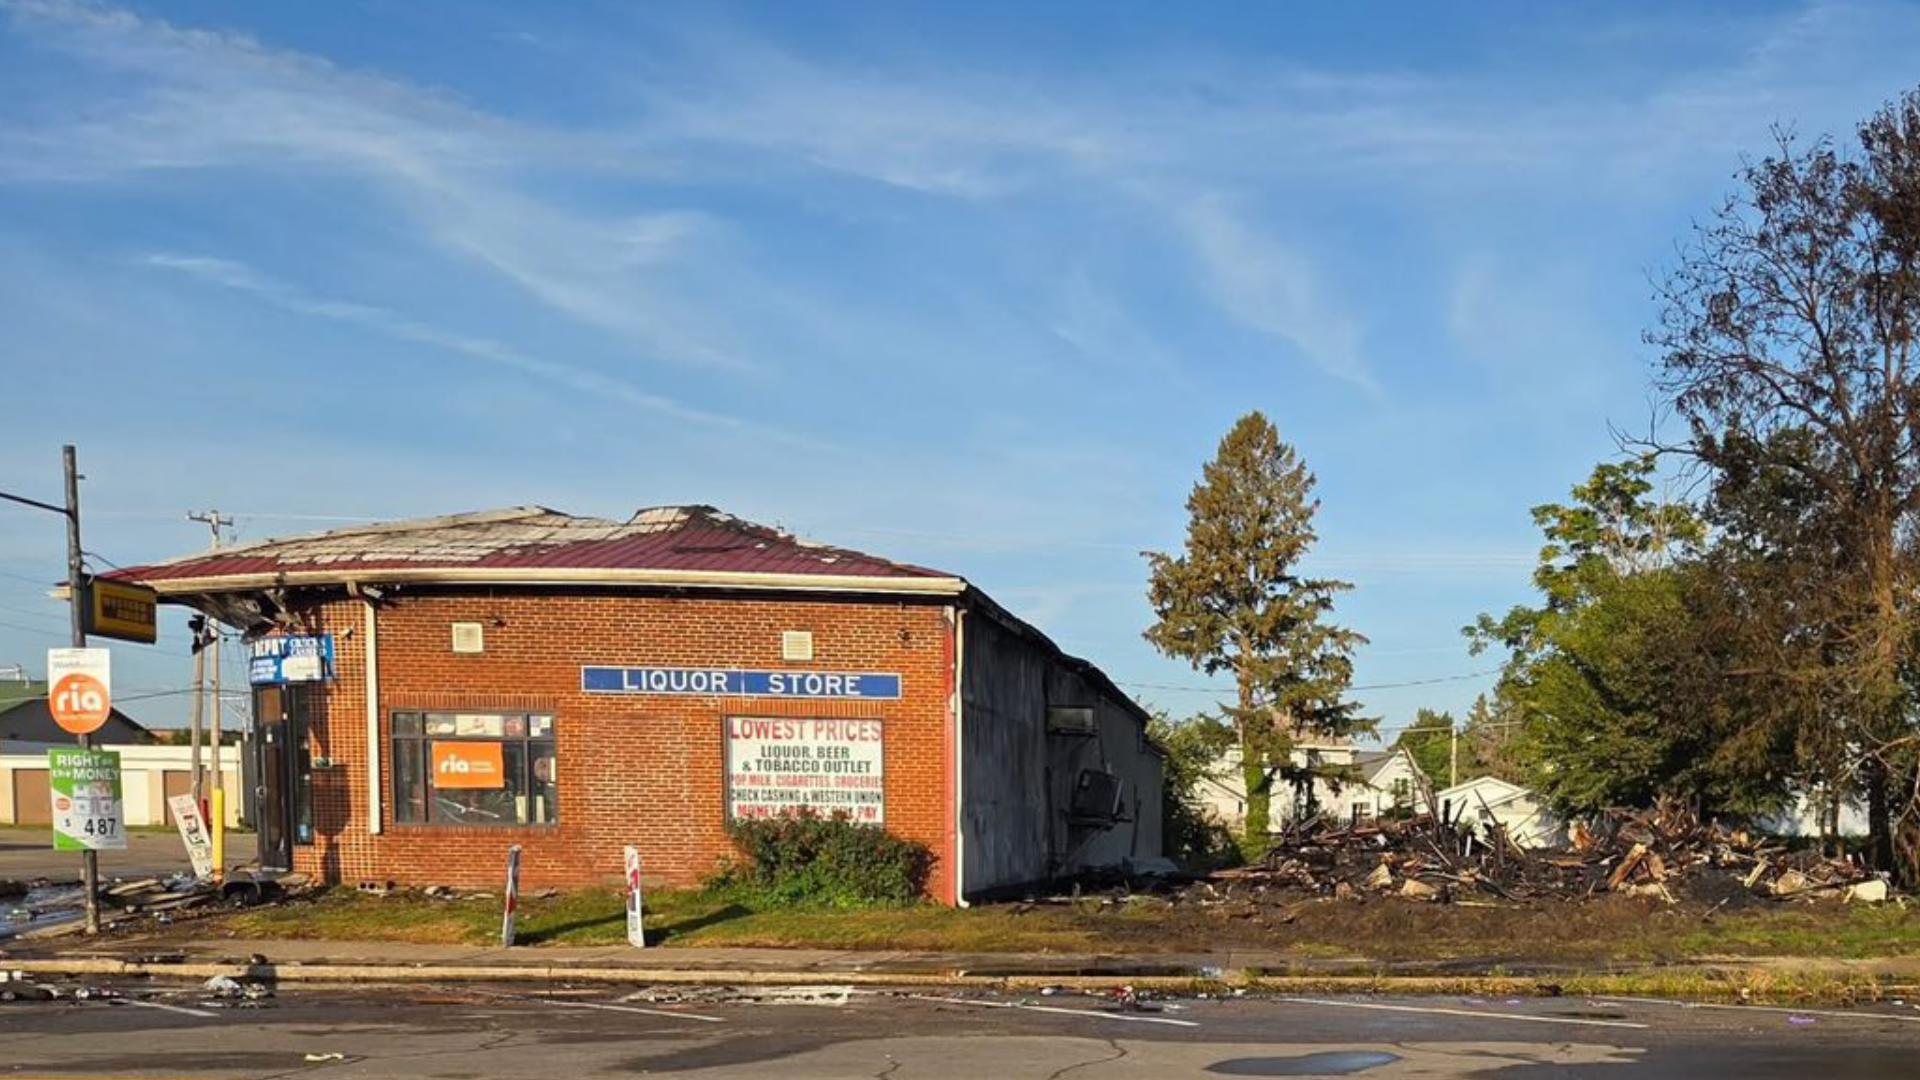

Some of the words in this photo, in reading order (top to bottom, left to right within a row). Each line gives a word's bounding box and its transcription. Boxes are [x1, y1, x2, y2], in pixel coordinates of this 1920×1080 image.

[623, 670, 728, 692] LIQUOR
[768, 674, 861, 695] STORE
[56, 682, 103, 712] ria
[729, 719, 804, 740] LOWEST
[813, 720, 881, 741] PRICES
[57, 754, 101, 766] RIGHT
[817, 746, 850, 759] BEER
[440, 754, 470, 774] ria
[742, 760, 752, 772] &
[755, 759, 820, 773] TOBACCO
[823, 761, 872, 773] OUTLET
[73, 768, 118, 780] MONEY
[730, 788, 759, 802] CHECK
[761, 789, 801, 803] CASHING
[803, 791, 809, 803] &
[811, 790, 852, 803] WESTERN
[855, 791, 881, 805] UNION
[85, 818, 116, 836] 487
